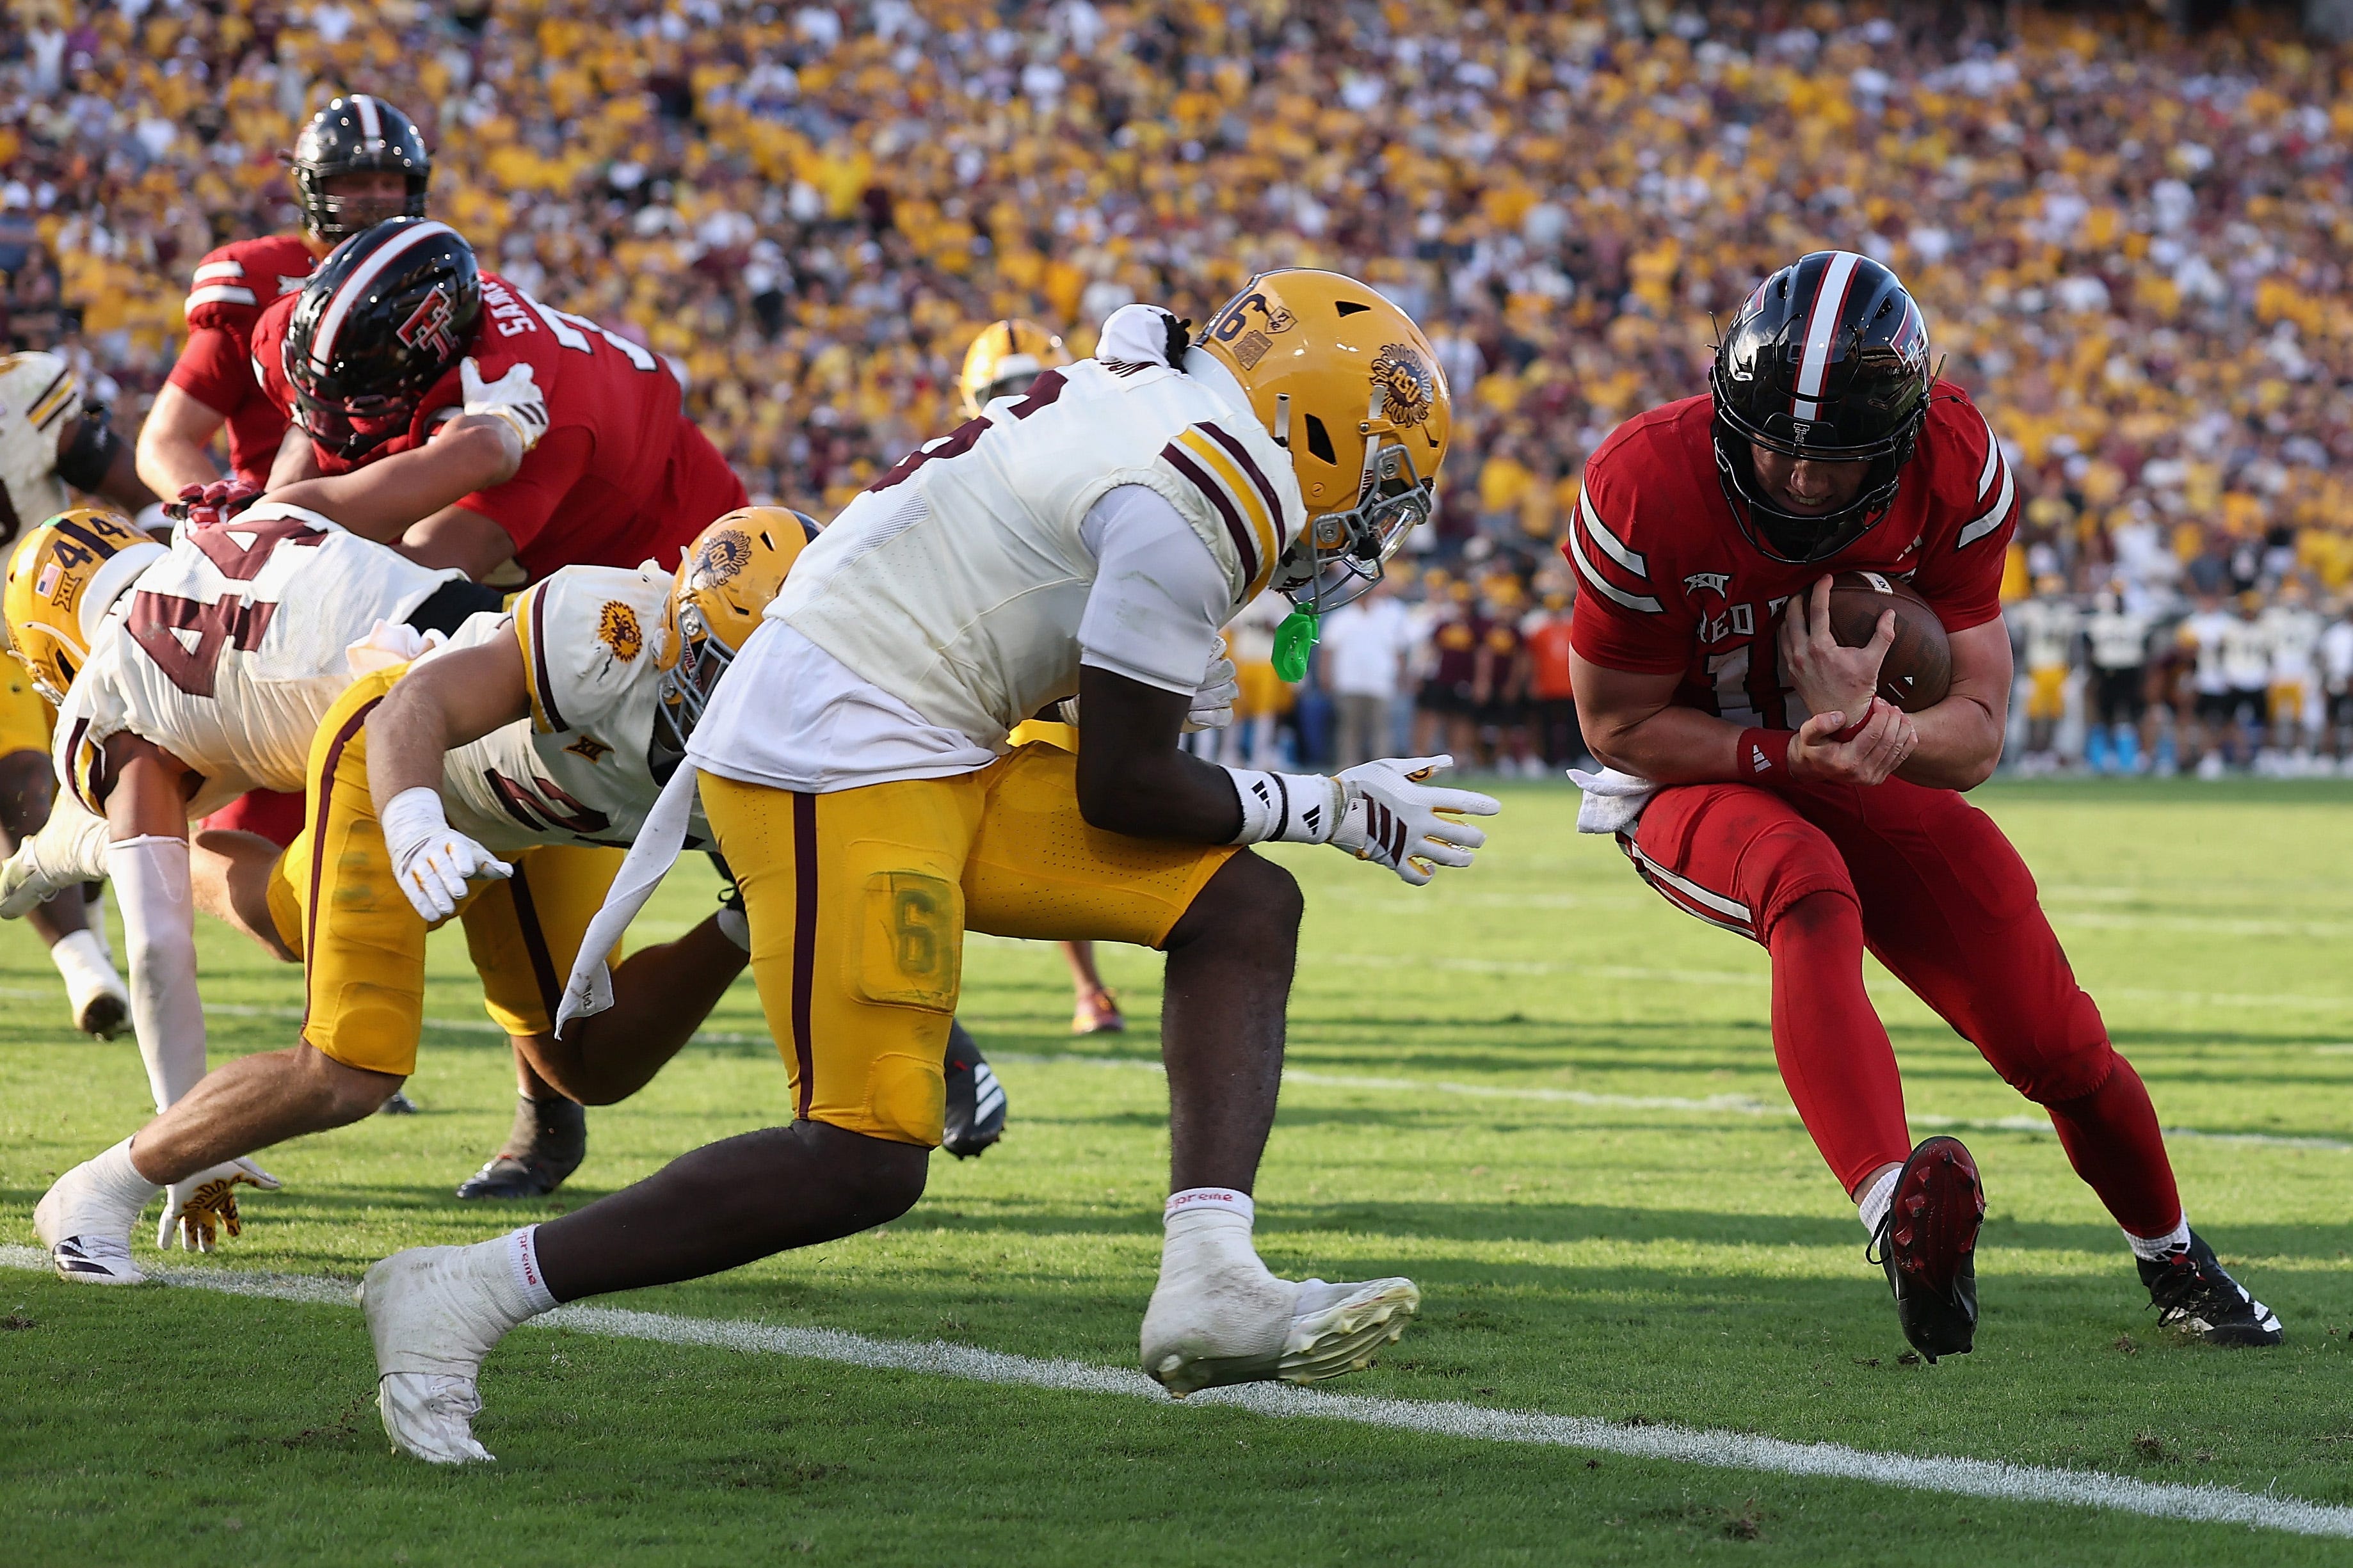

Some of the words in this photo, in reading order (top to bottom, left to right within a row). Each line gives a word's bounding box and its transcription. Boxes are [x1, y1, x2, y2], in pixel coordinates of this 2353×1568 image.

[1217, 294, 1265, 341] 6
[1389, 365, 1421, 403] ASU
[52, 516, 129, 569] 44
[124, 516, 328, 698] 44
[896, 888, 937, 973] 6
